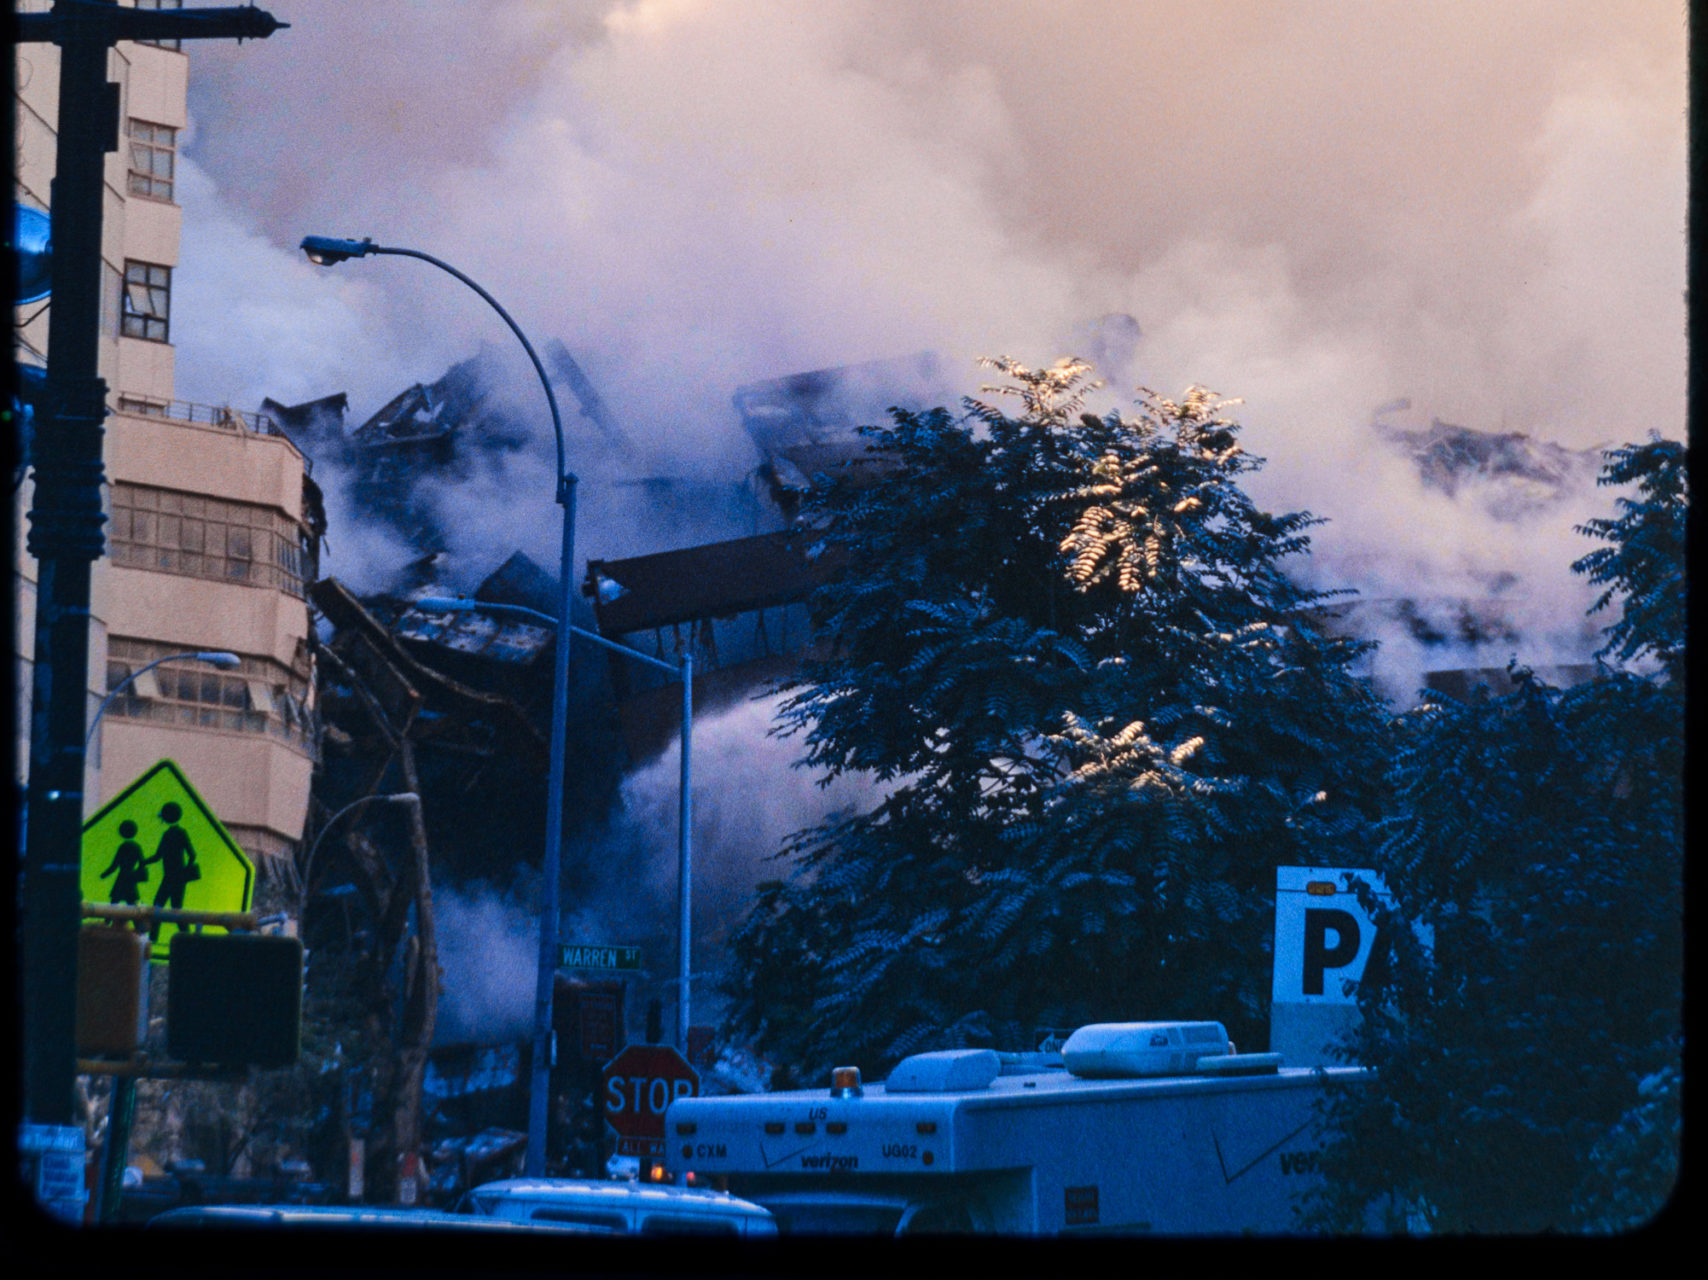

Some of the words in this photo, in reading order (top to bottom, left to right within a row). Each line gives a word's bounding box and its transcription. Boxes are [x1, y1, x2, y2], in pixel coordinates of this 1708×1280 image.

[563, 947, 617, 968] WARREN
[625, 950, 637, 961] ST
[605, 1075, 693, 1115] STOP
[648, 1141, 665, 1155] WA
[697, 1144, 727, 1158] CXM
[801, 1153, 859, 1171] verizon
[1280, 1151, 1319, 1175] ver
